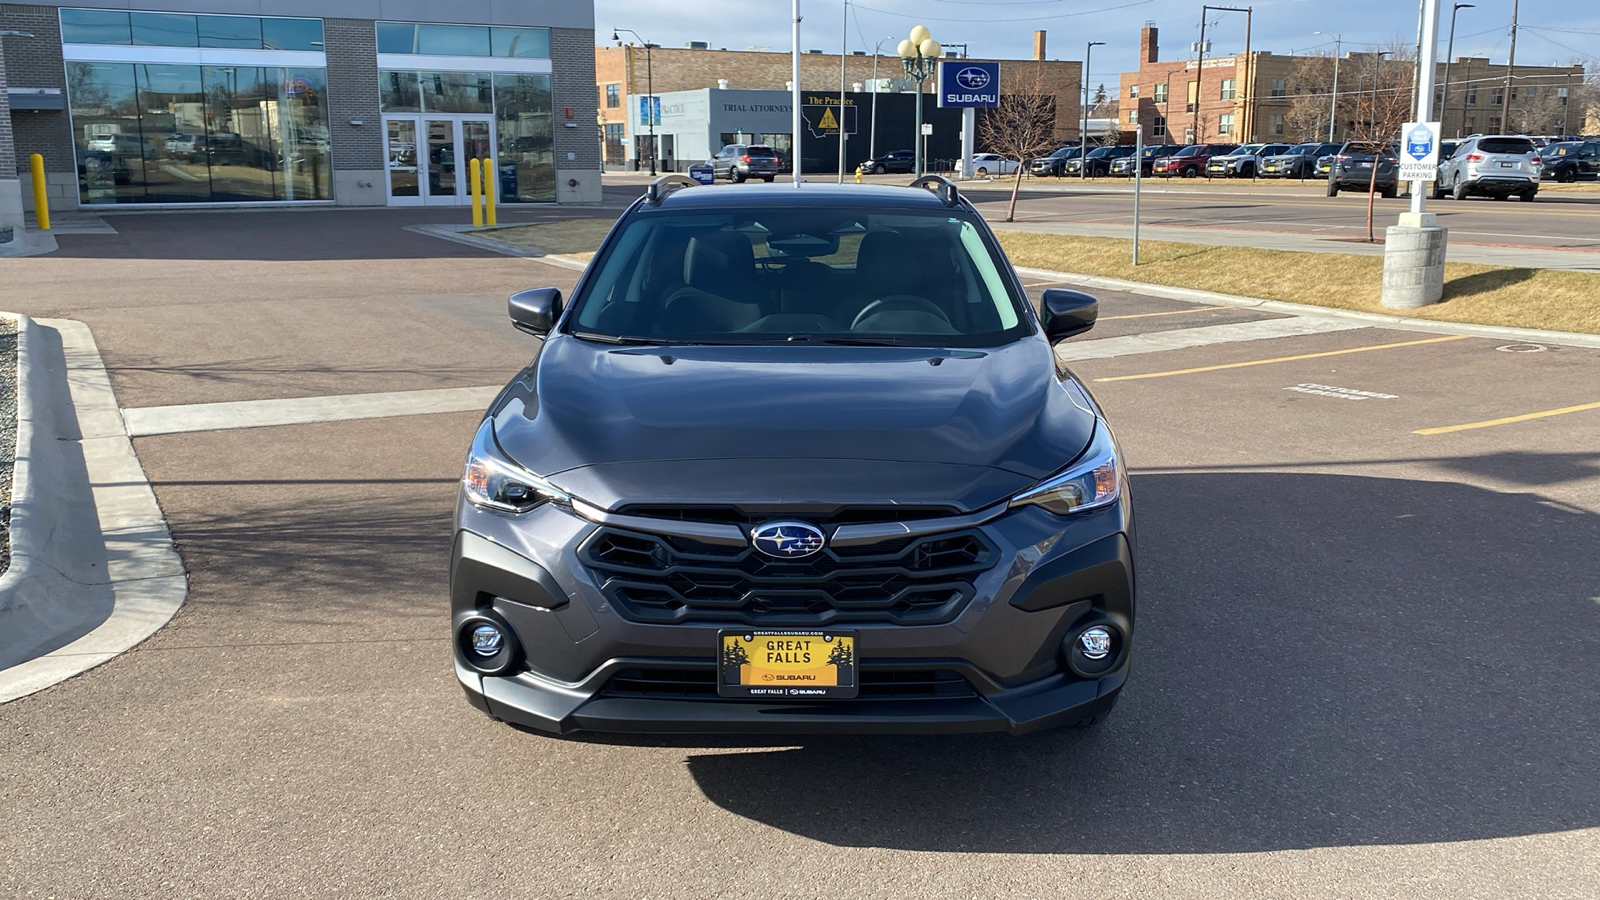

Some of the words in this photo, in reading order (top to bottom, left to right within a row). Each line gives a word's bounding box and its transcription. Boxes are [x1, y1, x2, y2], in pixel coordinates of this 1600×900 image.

[808, 96, 823, 105] The
[824, 96, 854, 106] Pracice
[947, 94, 996, 103] SUBARU
[723, 103, 747, 112] TRIAL
[1402, 171, 1433, 179] PARKING
[766, 640, 811, 651] GREAT
[766, 652, 811, 664] FALLS
